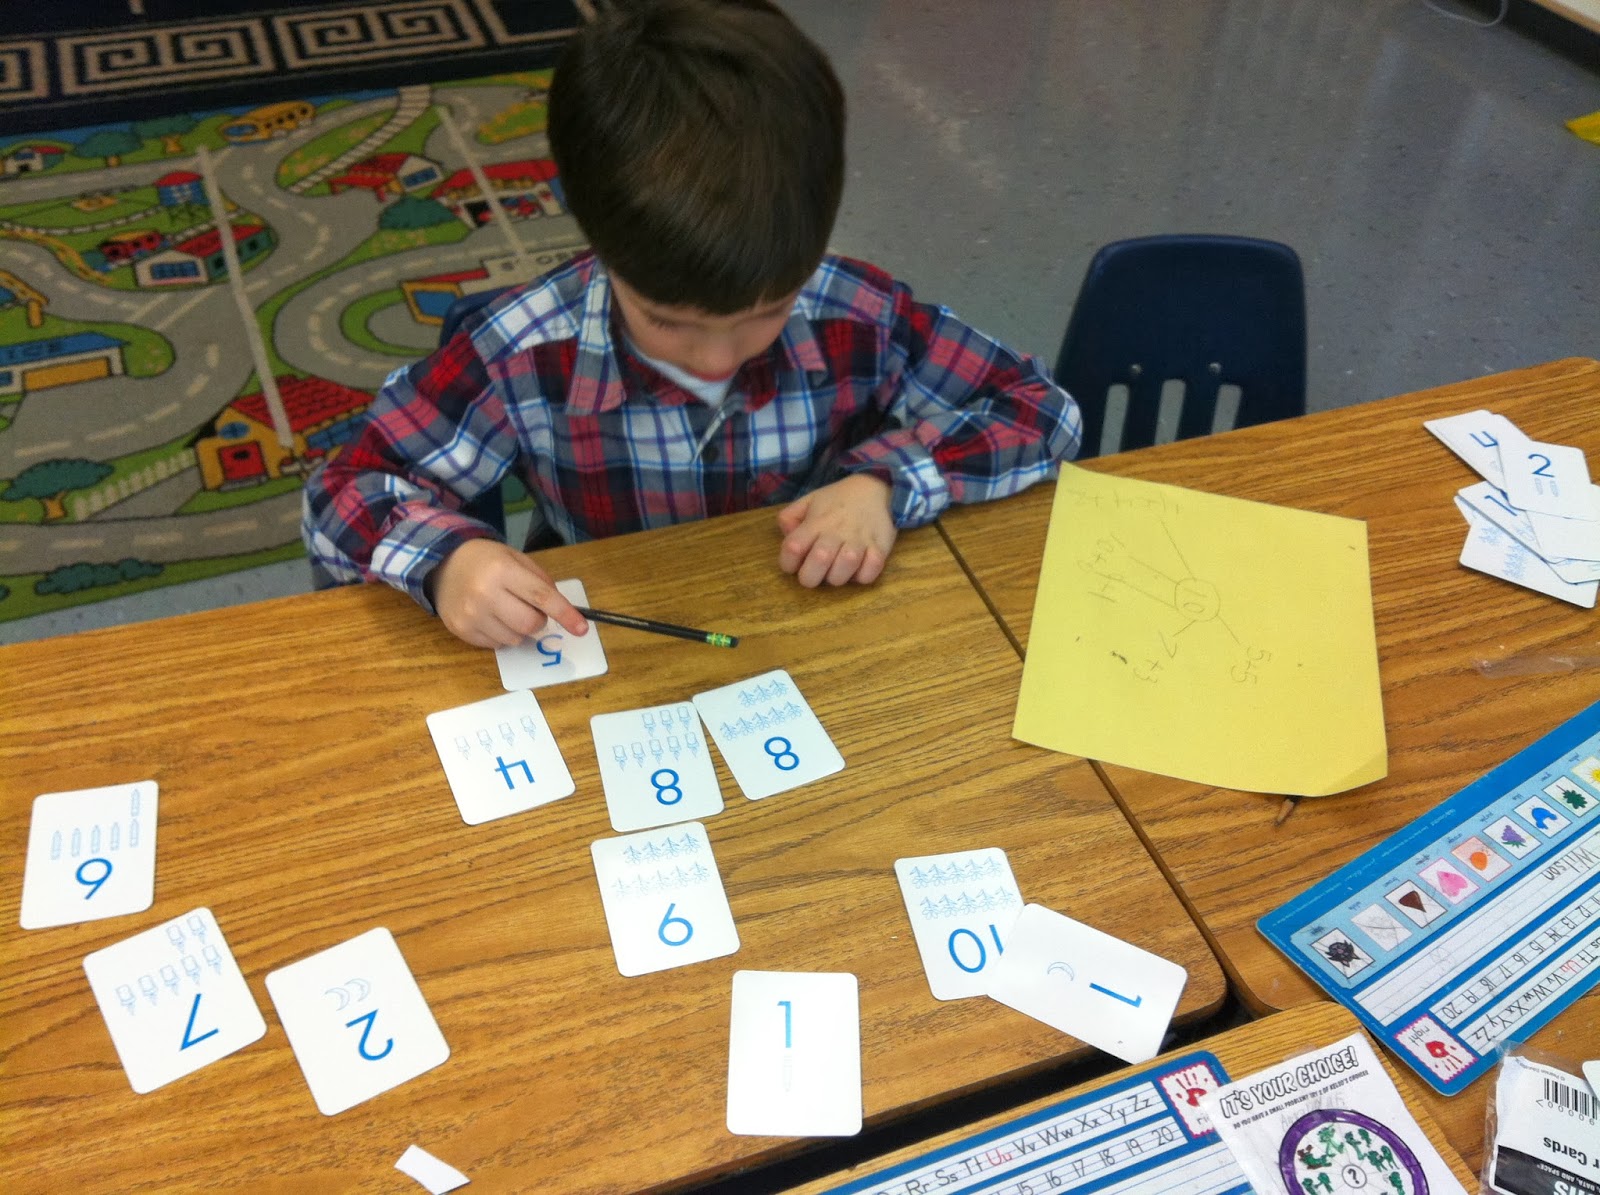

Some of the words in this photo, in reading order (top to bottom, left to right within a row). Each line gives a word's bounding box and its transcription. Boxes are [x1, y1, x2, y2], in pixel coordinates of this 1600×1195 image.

[1527, 453, 1555, 478] 2
[1484, 495, 1517, 517] 1
[536, 634, 563, 668] 5
[764, 736, 801, 772] 8
[496, 757, 535, 790] 4
[650, 768, 684, 806] 8
[1541, 847, 1600, 880] Wilson
[76, 858, 113, 899] 6
[1575, 905, 1593, 918] 12
[659, 903, 694, 946] 9
[1561, 916, 1578, 930] 13
[1529, 940, 1546, 955] 15
[1512, 952, 1530, 967] 16
[1500, 965, 1513, 980] 17
[1480, 976, 1497, 992] 18
[1523, 984, 1553, 1002] Ww
[1089, 983, 1143, 1008] 1
[1461, 989, 1479, 1005] 19
[1441, 1002, 1463, 1020] 20
[1505, 999, 1530, 1016] Xx
[180, 994, 219, 1050] 7
[778, 1001, 792, 1048] 1
[1486, 1013, 1513, 1030] Yy
[347, 1010, 395, 1061] 2
[1409, 1025, 1430, 1046] right
[1472, 1026, 1493, 1042] Zz
[1219, 1090, 1254, 1118] IT'S
[1250, 1072, 1297, 1105] YOUR
[1296, 1045, 1359, 1088] CHOICE!
[1269, 1106, 1284, 1115] SMALL
[935, 1170, 958, 1186] Ss
[959, 1156, 983, 1175] Tt
[985, 1149, 1013, 1166] Uu
[1012, 1138, 1036, 1155] Vv
[1037, 1126, 1074, 1146] Ww
[1075, 1114, 1101, 1133] Xx
[1101, 1104, 1127, 1124] Yy
[1127, 1095, 1152, 1112] Zz
[1543, 1137, 1588, 1166] Cards
[1044, 1170, 1062, 1189] 16
[1072, 1159, 1085, 1178] 17
[1099, 1150, 1116, 1167] 18
[1125, 1138, 1145, 1157] 19
[1151, 1126, 1174, 1146] 20
[1347, 1168, 1360, 1185] ?
[1561, 1171, 1576, 1183] AND
